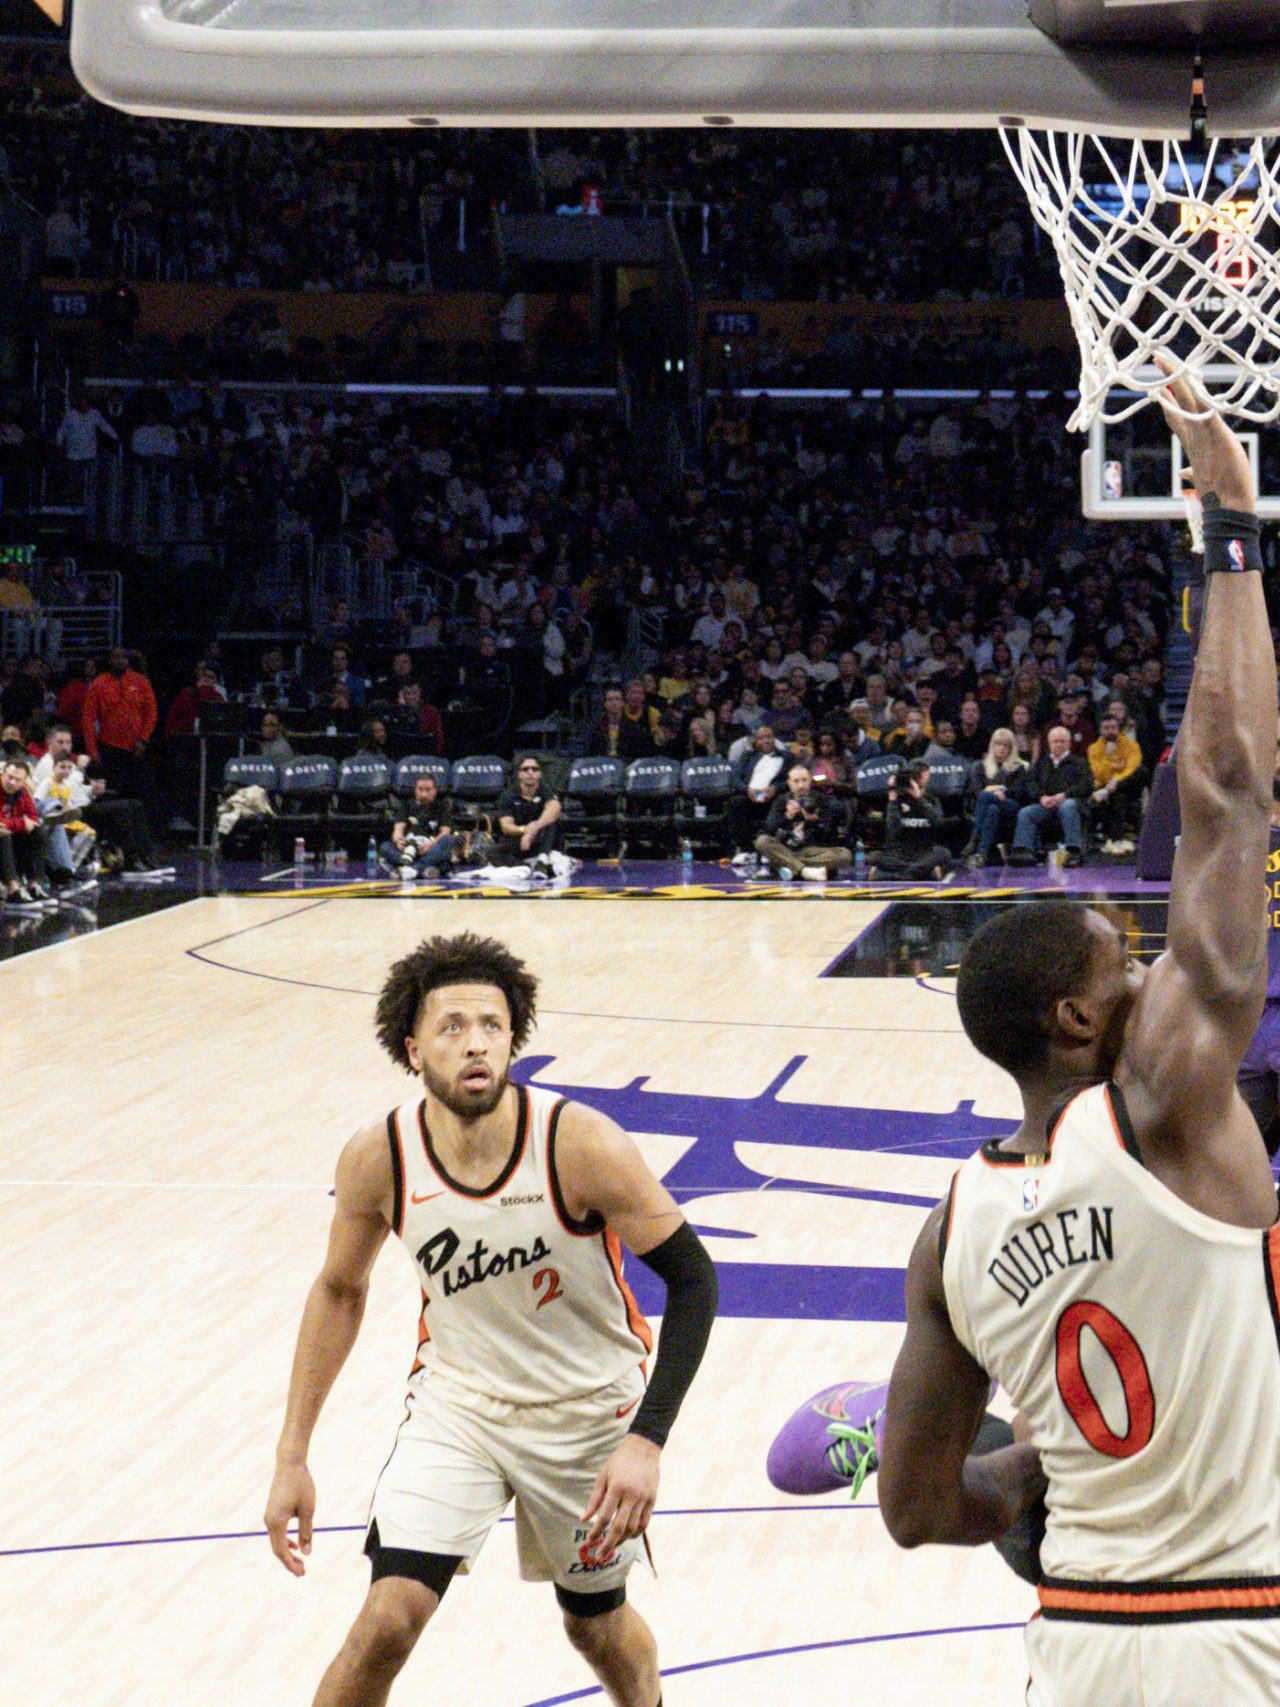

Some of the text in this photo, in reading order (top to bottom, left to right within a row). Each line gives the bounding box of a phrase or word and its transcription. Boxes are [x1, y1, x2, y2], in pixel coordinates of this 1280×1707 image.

[0, 545, 36, 565] XIT
[241, 764, 275, 772] DELTA
[296, 763, 330, 774] DELTA
[353, 763, 388, 774] DELTA
[411, 765, 445, 773] DELTA
[468, 765, 502, 773] DELTA
[581, 764, 616, 776] DELTA
[638, 765, 673, 775] DELTA
[697, 764, 732, 774] DELTA
[929, 764, 965, 774] DELTA
[500, 1193, 544, 1206] StockX
[415, 1227, 551, 1297] Pistons
[988, 1207, 1114, 1308] DUREN
[532, 1268, 564, 1311] 2
[1055, 1301, 1156, 1459] 0
